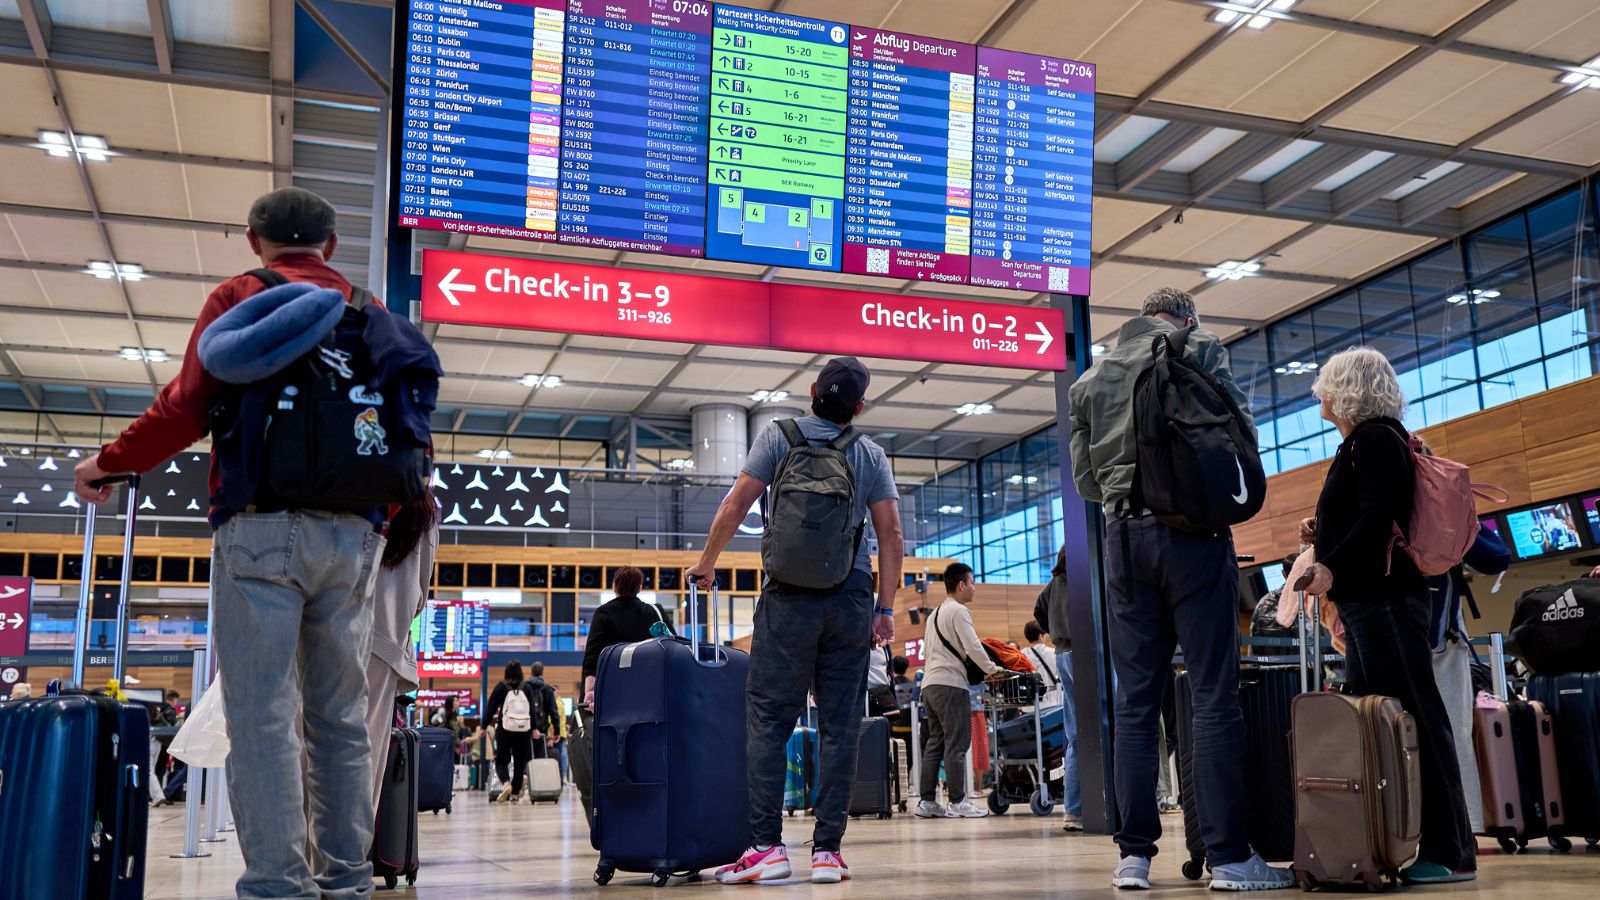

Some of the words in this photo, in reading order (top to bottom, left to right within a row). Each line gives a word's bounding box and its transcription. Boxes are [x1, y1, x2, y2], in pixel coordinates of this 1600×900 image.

[438, 4, 468, 18] Venedig
[472, 0, 503, 11] Mallorca
[569, 6, 584, 14] Flight
[606, 5, 626, 13] Schalter
[672, 0, 709, 17] 07:04
[413, 11, 434, 22] 06:00
[569, 14, 578, 23] SR
[579, 16, 596, 26] 2412
[605, 11, 627, 20] Check-in
[651, 12, 680, 24] Bemerkung
[717, 7, 753, 21] Wartezeit
[754, 12, 825, 32] Sicherheitskontrolle
[438, 15, 479, 28] Amsterdam
[604, 20, 633, 31] 011-012
[651, 18, 669, 27] Remark
[716, 16, 738, 28] Waiting
[739, 19, 754, 29] Time
[754, 22, 778, 34] Security
[778, 26, 800, 36] Control
[438, 26, 468, 37] Lissabon
[651, 27, 677, 37] Erwartet
[678, 32, 696, 41] 07:20
[833, 30, 843, 39] T1
[412, 33, 433, 43] 06:10
[437, 36, 461, 47] Dublin
[568, 36, 577, 44] KL
[578, 37, 595, 46] 1770
[604, 40, 632, 52] 811-816
[748, 40, 752, 49] 1
[873, 32, 910, 52] Abflug
[913, 40, 957, 57] Departure
[436, 47, 455, 57] Paris
[455, 50, 471, 59] CDG
[411, 54, 432, 65] 06:25
[436, 58, 480, 71] Thessaloniki
[1040, 59, 1047, 71] 3
[567, 66, 595, 77] EJU5159
[747, 62, 753, 71] 2
[872, 62, 896, 72] Helsinki
[1062, 63, 1093, 78] 07:04
[435, 68, 458, 79] Zürich
[649, 68, 673, 80] Einstieg
[674, 71, 700, 82] beendet
[872, 71, 908, 83] Saarbrücken
[410, 76, 430, 86] 06:45
[435, 79, 469, 91] Frankfurt
[872, 81, 901, 92] Barcelona
[746, 85, 752, 94] 4
[1057, 90, 1076, 99] Service
[409, 97, 430, 107] 06:55
[435, 90, 462, 101] London
[462, 93, 477, 104] City
[477, 96, 503, 106] Airport
[434, 101, 473, 113] Köln/Bonn
[745, 107, 752, 116] 5
[434, 111, 460, 122] Brüssel
[565, 108, 575, 116] BA
[576, 109, 593, 119] 8490
[871, 110, 899, 121] Frankfurt
[408, 119, 429, 129] 07:00
[433, 122, 451, 132] Genf
[746, 127, 756, 137] T2
[432, 133, 466, 145] Stuttgart
[870, 139, 904, 150] Amsterdam
[407, 141, 428, 151] 07:00
[432, 143, 451, 154] Wien
[432, 154, 450, 164] Paris
[450, 157, 466, 167] Orly
[782, 157, 803, 167] Priority
[405, 162, 426, 172] 07:05
[431, 165, 458, 176] London
[459, 168, 474, 178] LHR
[431, 176, 448, 185] Rom
[448, 178, 463, 187] FCO
[645, 170, 673, 181] Check-in
[674, 174, 699, 184] beendet
[404, 184, 426, 194] 07:15
[562, 181, 573, 190] BA
[575, 183, 588, 192] 999
[793, 180, 815, 190] Runway
[869, 178, 901, 189] Düsseldorf
[430, 187, 450, 197] Basel
[599, 185, 627, 196] 221-226
[869, 188, 885, 197] Nizza
[1044, 190, 1075, 202] Abfertigung
[645, 191, 669, 203] Einstieg
[727, 193, 734, 203] 5
[429, 198, 452, 208] Zürich
[819, 203, 825, 214] 1
[868, 198, 891, 208] Belgrad
[404, 206, 425, 216] 07:20
[429, 208, 463, 220] München
[751, 207, 759, 217] 4
[868, 208, 891, 218] Antalya
[403, 217, 418, 226] BER
[794, 212, 801, 222] 2
[442, 221, 457, 229] Von
[457, 223, 475, 232] jeder
[477, 224, 542, 239] Sicherheitskontrolle
[543, 232, 557, 241] sind
[561, 223, 571, 232] LH
[572, 225, 588, 233] 1963
[867, 227, 902, 237] Manchester
[560, 234, 590, 244] sämtliche
[591, 237, 630, 249] Abfluggates
[630, 241, 664, 252] erreichbar.
[643, 232, 668, 243] Einstieg
[815, 248, 826, 260] T2
[896, 248, 918, 258] Weitere
[919, 252, 940, 262] Abflüge
[896, 257, 915, 266] finden
[924, 260, 936, 269] hier
[1014, 261, 1023, 269] for
[1023, 262, 1042, 271] further
[1013, 270, 1042, 279] Departures
[484, 268, 608, 302] Check-in
[970, 276, 985, 286] Bulky
[986, 278, 1009, 288] Baggage
[861, 302, 964, 333] Check-in
[1542, 607, 1584, 622] adidas
[5, 671, 16, 679] T2
